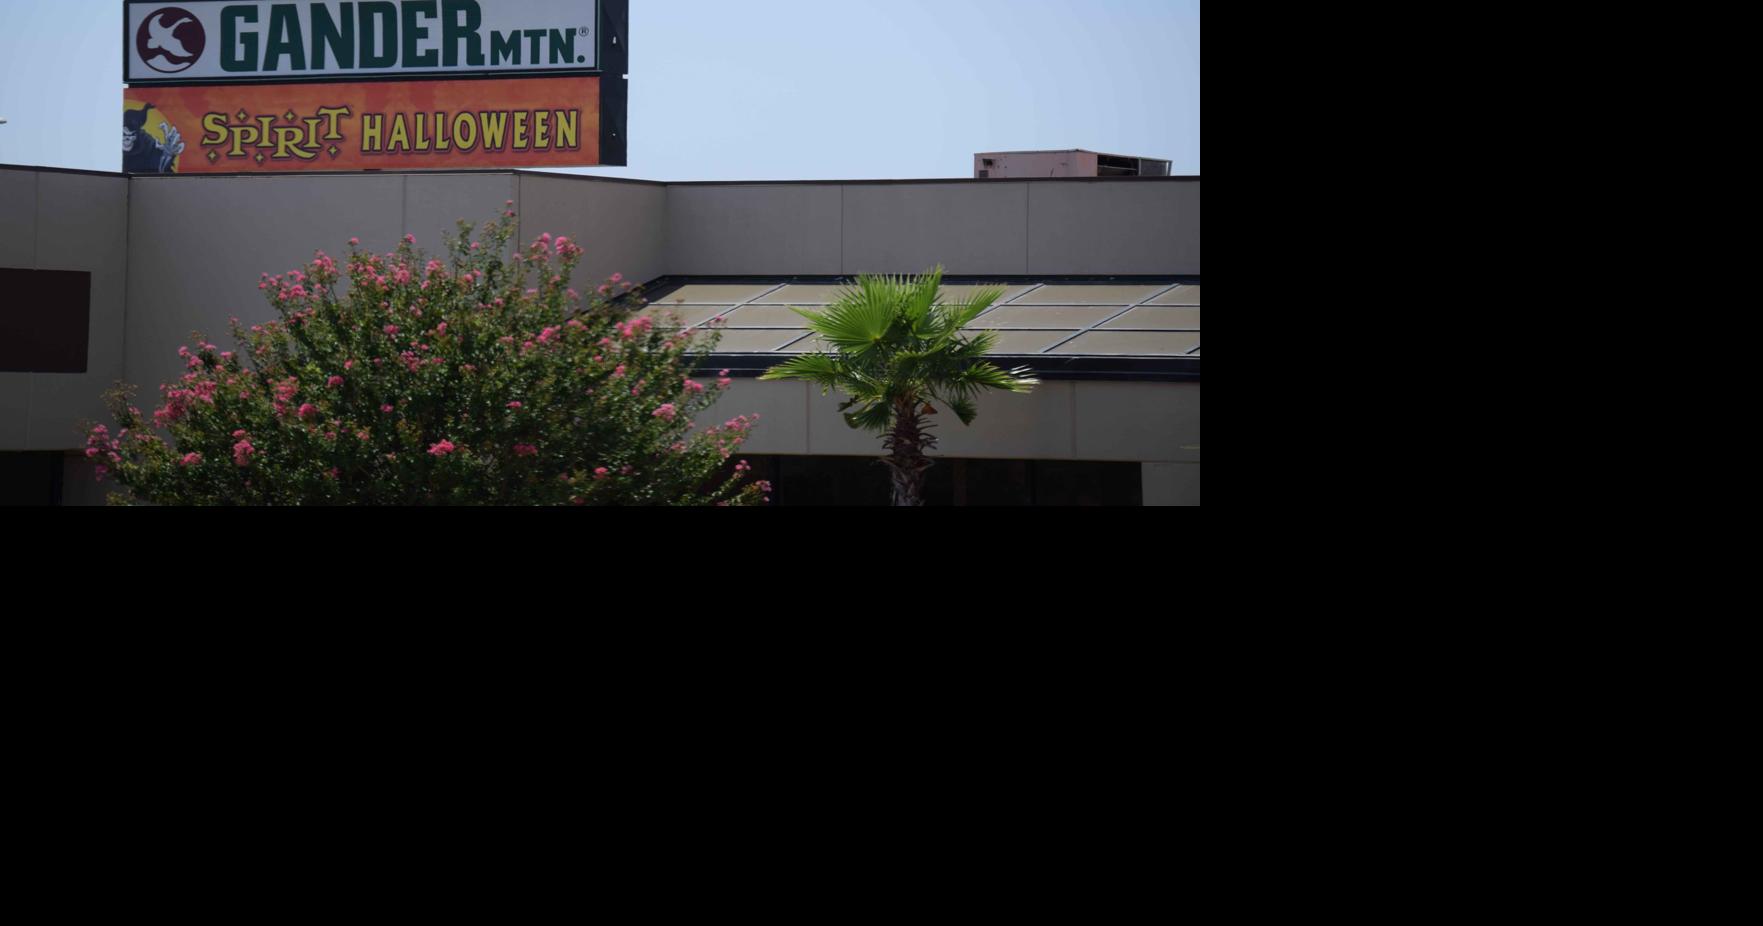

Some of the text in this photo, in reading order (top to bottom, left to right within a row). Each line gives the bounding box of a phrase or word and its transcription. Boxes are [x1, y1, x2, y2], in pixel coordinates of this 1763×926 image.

[219, 0, 485, 72] GANDER
[202, 105, 580, 160] SPIRIT HALLOWEEN
